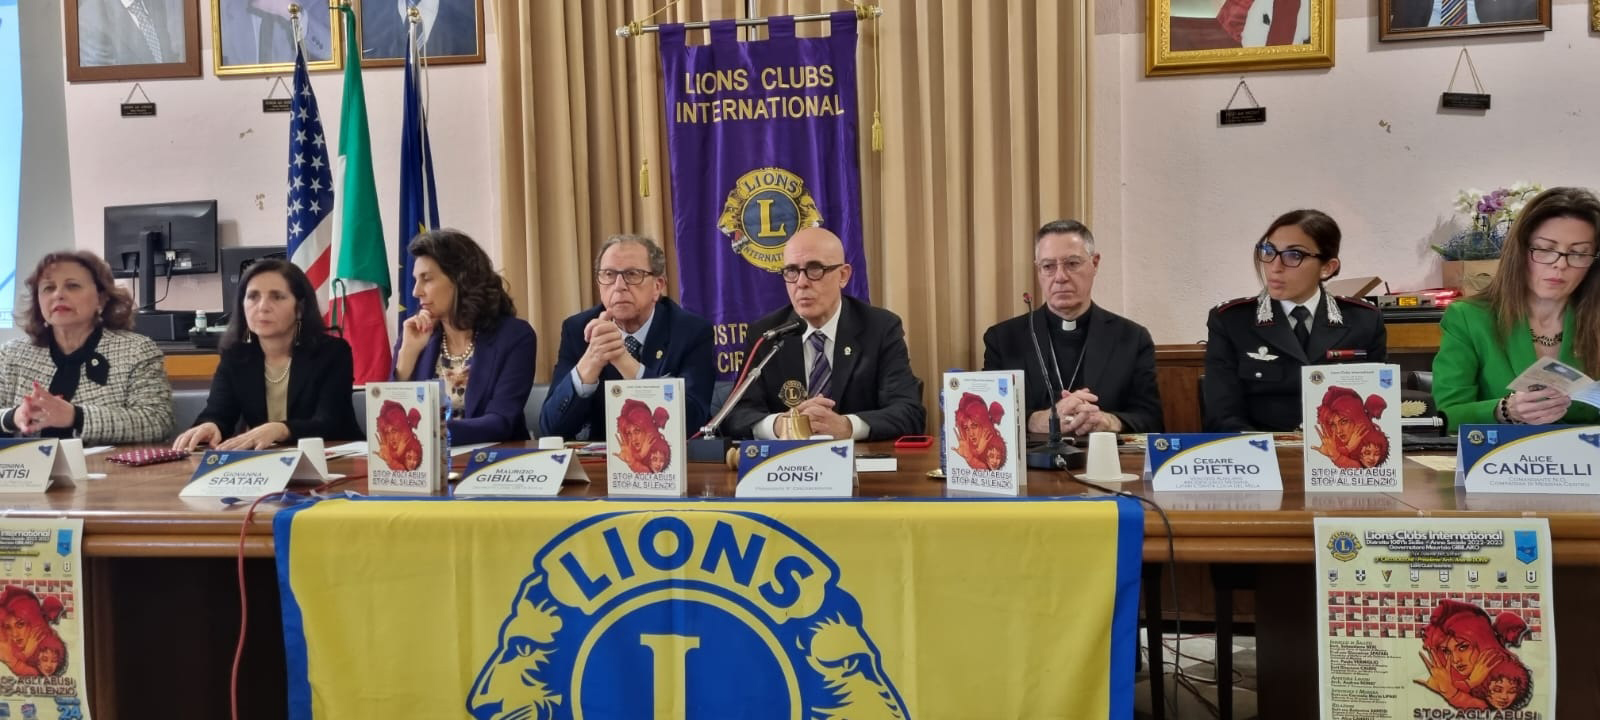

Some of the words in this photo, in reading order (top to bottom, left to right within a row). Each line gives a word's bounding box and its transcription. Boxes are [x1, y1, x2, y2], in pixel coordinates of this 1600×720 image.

[685, 68, 749, 95] LIONS
[761, 64, 834, 90] CLUBS
[676, 94, 845, 124] INTERNATIONAL
[743, 173, 799, 193] LIONS
[756, 199, 787, 238] L
[0, 469, 31, 479] NTISI
[1170, 465, 1189, 476] DI
[1193, 464, 1261, 476] PIETRO
[1311, 468, 1337, 477] STOP
[1340, 468, 1363, 477] AGLI
[1366, 468, 1397, 477] ABUSI
[1483, 462, 1593, 476] CANDELLI
[208, 477, 269, 486] SPATARI
[476, 474, 548, 483] GIBILARO
[1311, 477, 1336, 486] STOP
[1351, 477, 1397, 487] SILENZIO
[1365, 530, 1394, 540] Lions
[1395, 530, 1427, 540] Clubs
[1428, 530, 1503, 540] International
[559, 516, 814, 608] LIONS
[1414, 708, 1451, 718] STOP
[1455, 709, 1490, 719] AGLI
[1494, 710, 1537, 720] ABUSI
